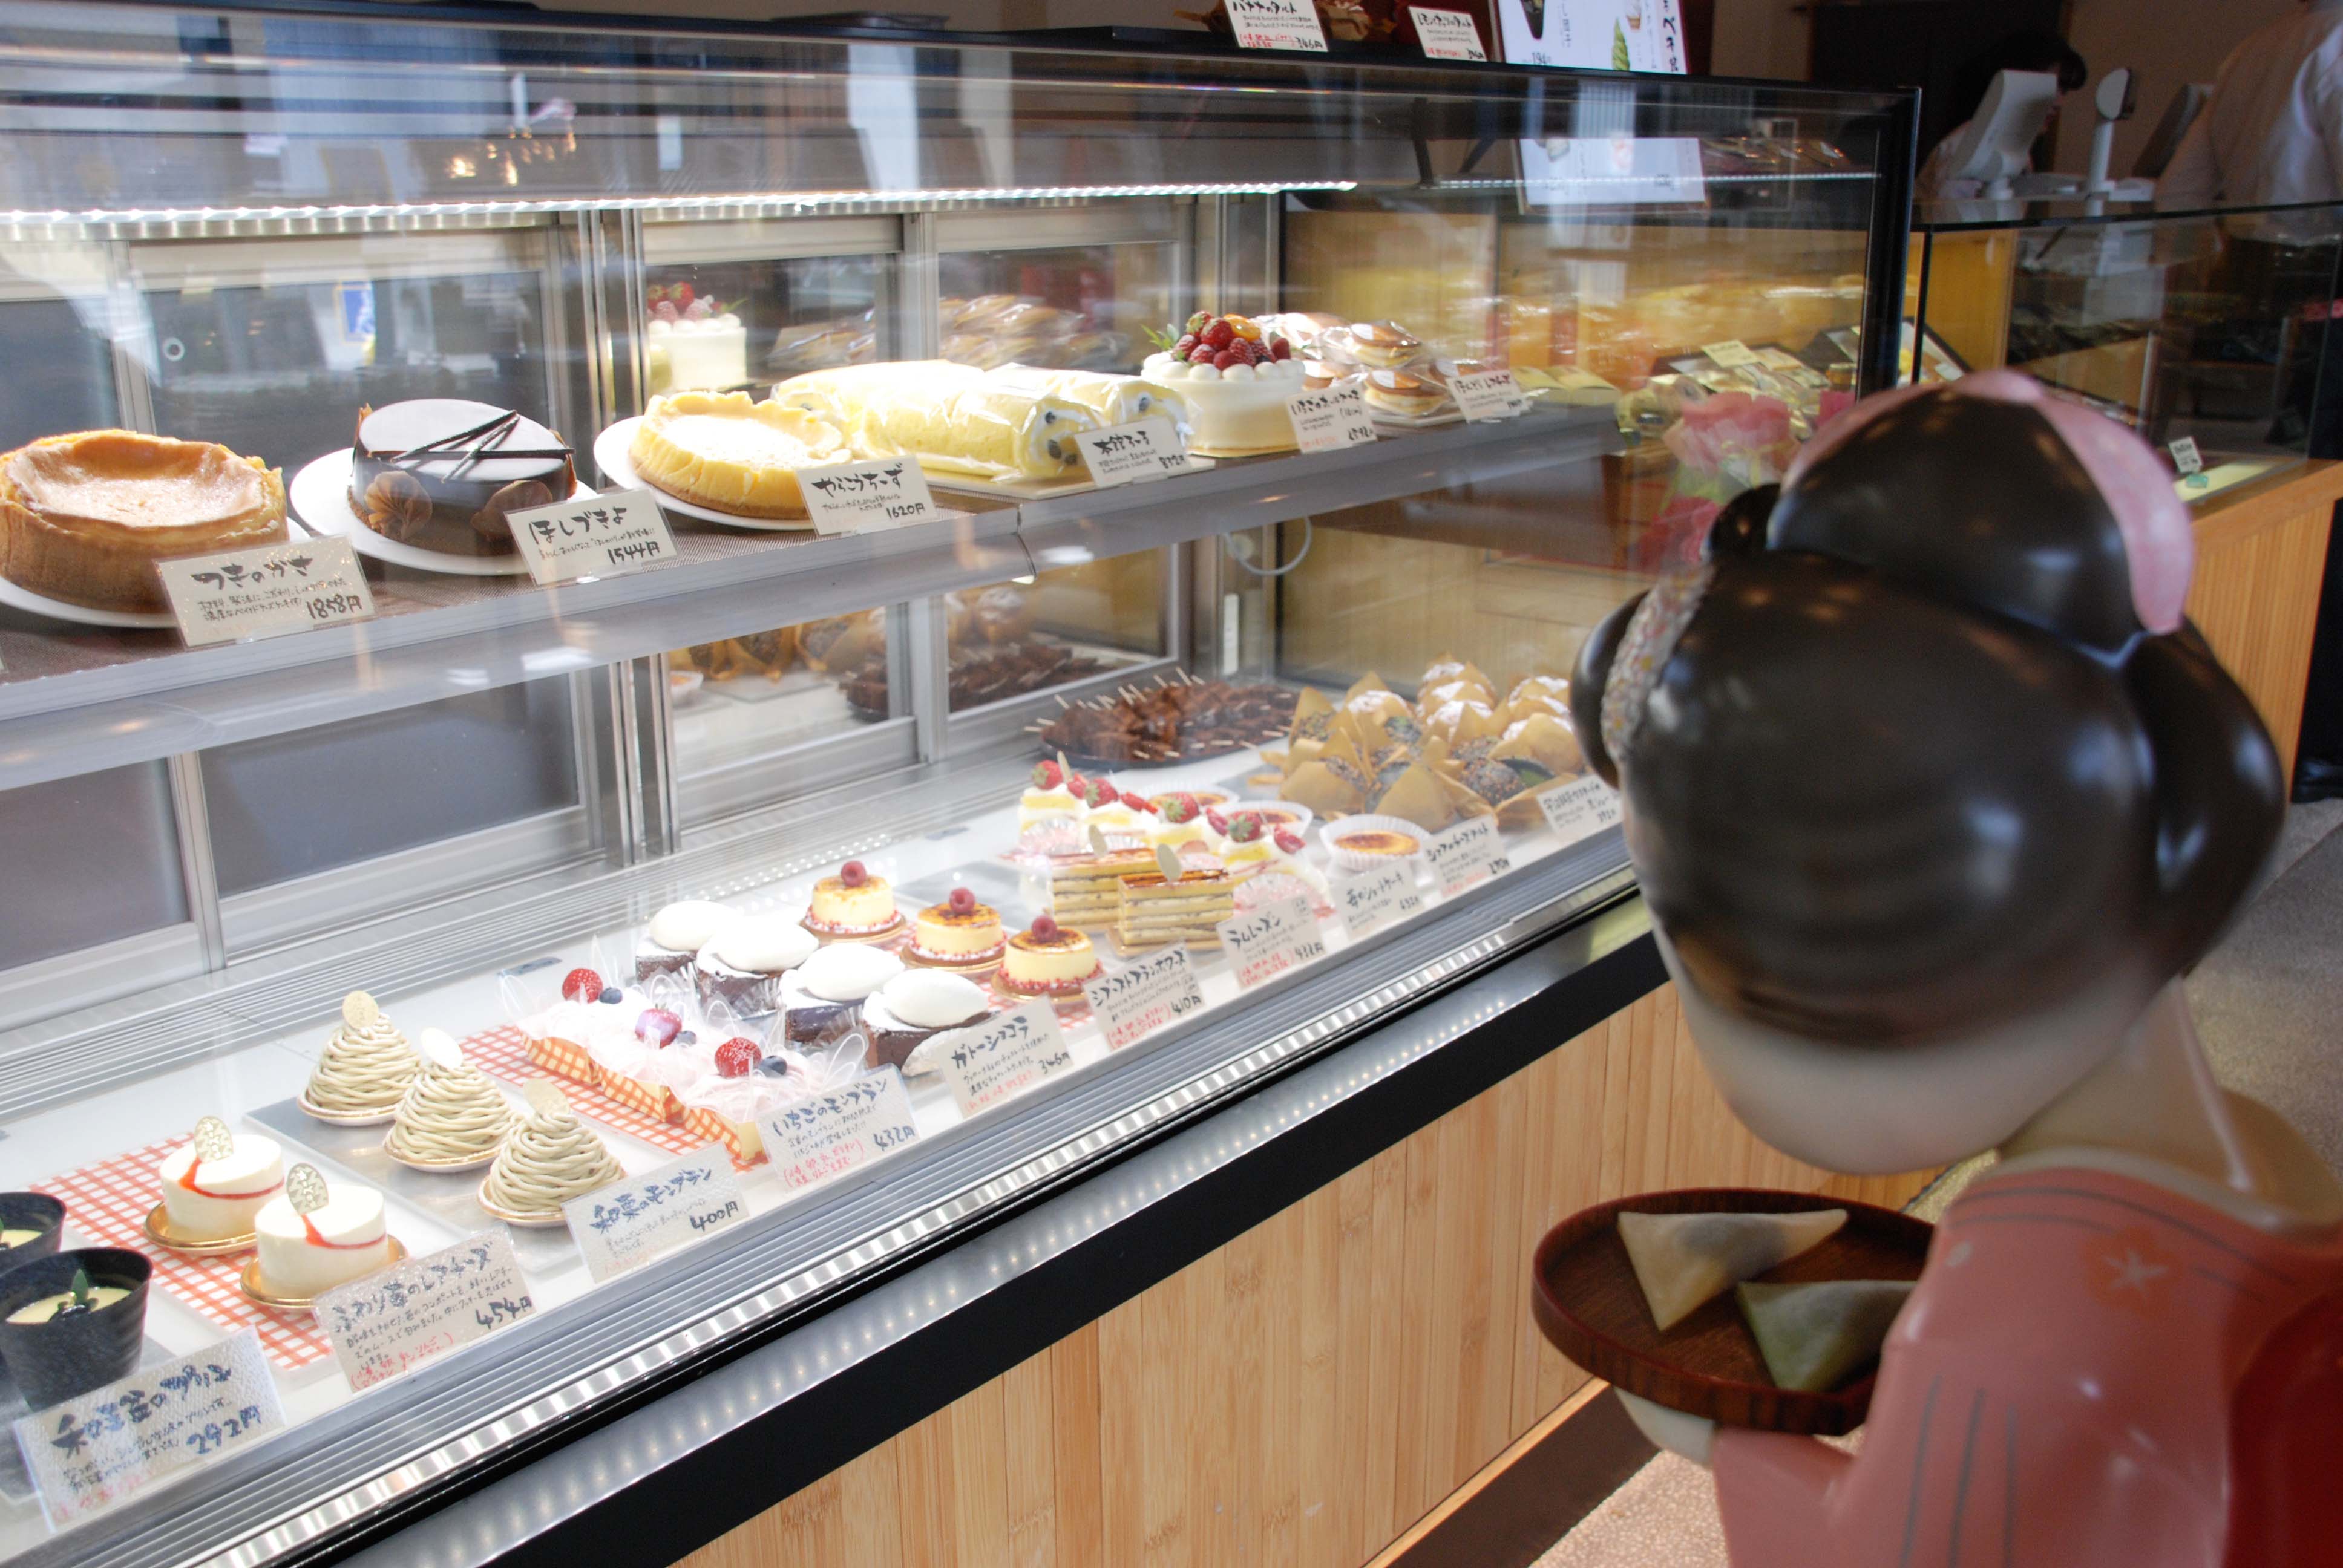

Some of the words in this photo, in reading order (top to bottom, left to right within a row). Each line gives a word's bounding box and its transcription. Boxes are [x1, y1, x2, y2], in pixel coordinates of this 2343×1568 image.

[529, 506, 627, 544] ほしづきよ
[886, 503, 925, 519] 1620円
[608, 541, 660, 564] 1544円
[306, 594, 362, 620] 1858円
[1171, 995, 1201, 1016] 410円
[951, 1016, 1029, 1070] ガトーショコラ
[773, 1078, 887, 1137] いちごのモンブラン
[873, 1126, 916, 1151] 432円
[590, 1168, 711, 1234] 和栗のモンブラン
[690, 1201, 738, 1232] 400円
[476, 1296, 532, 1330] 454円
[186, 1405, 261, 1454] 292円
